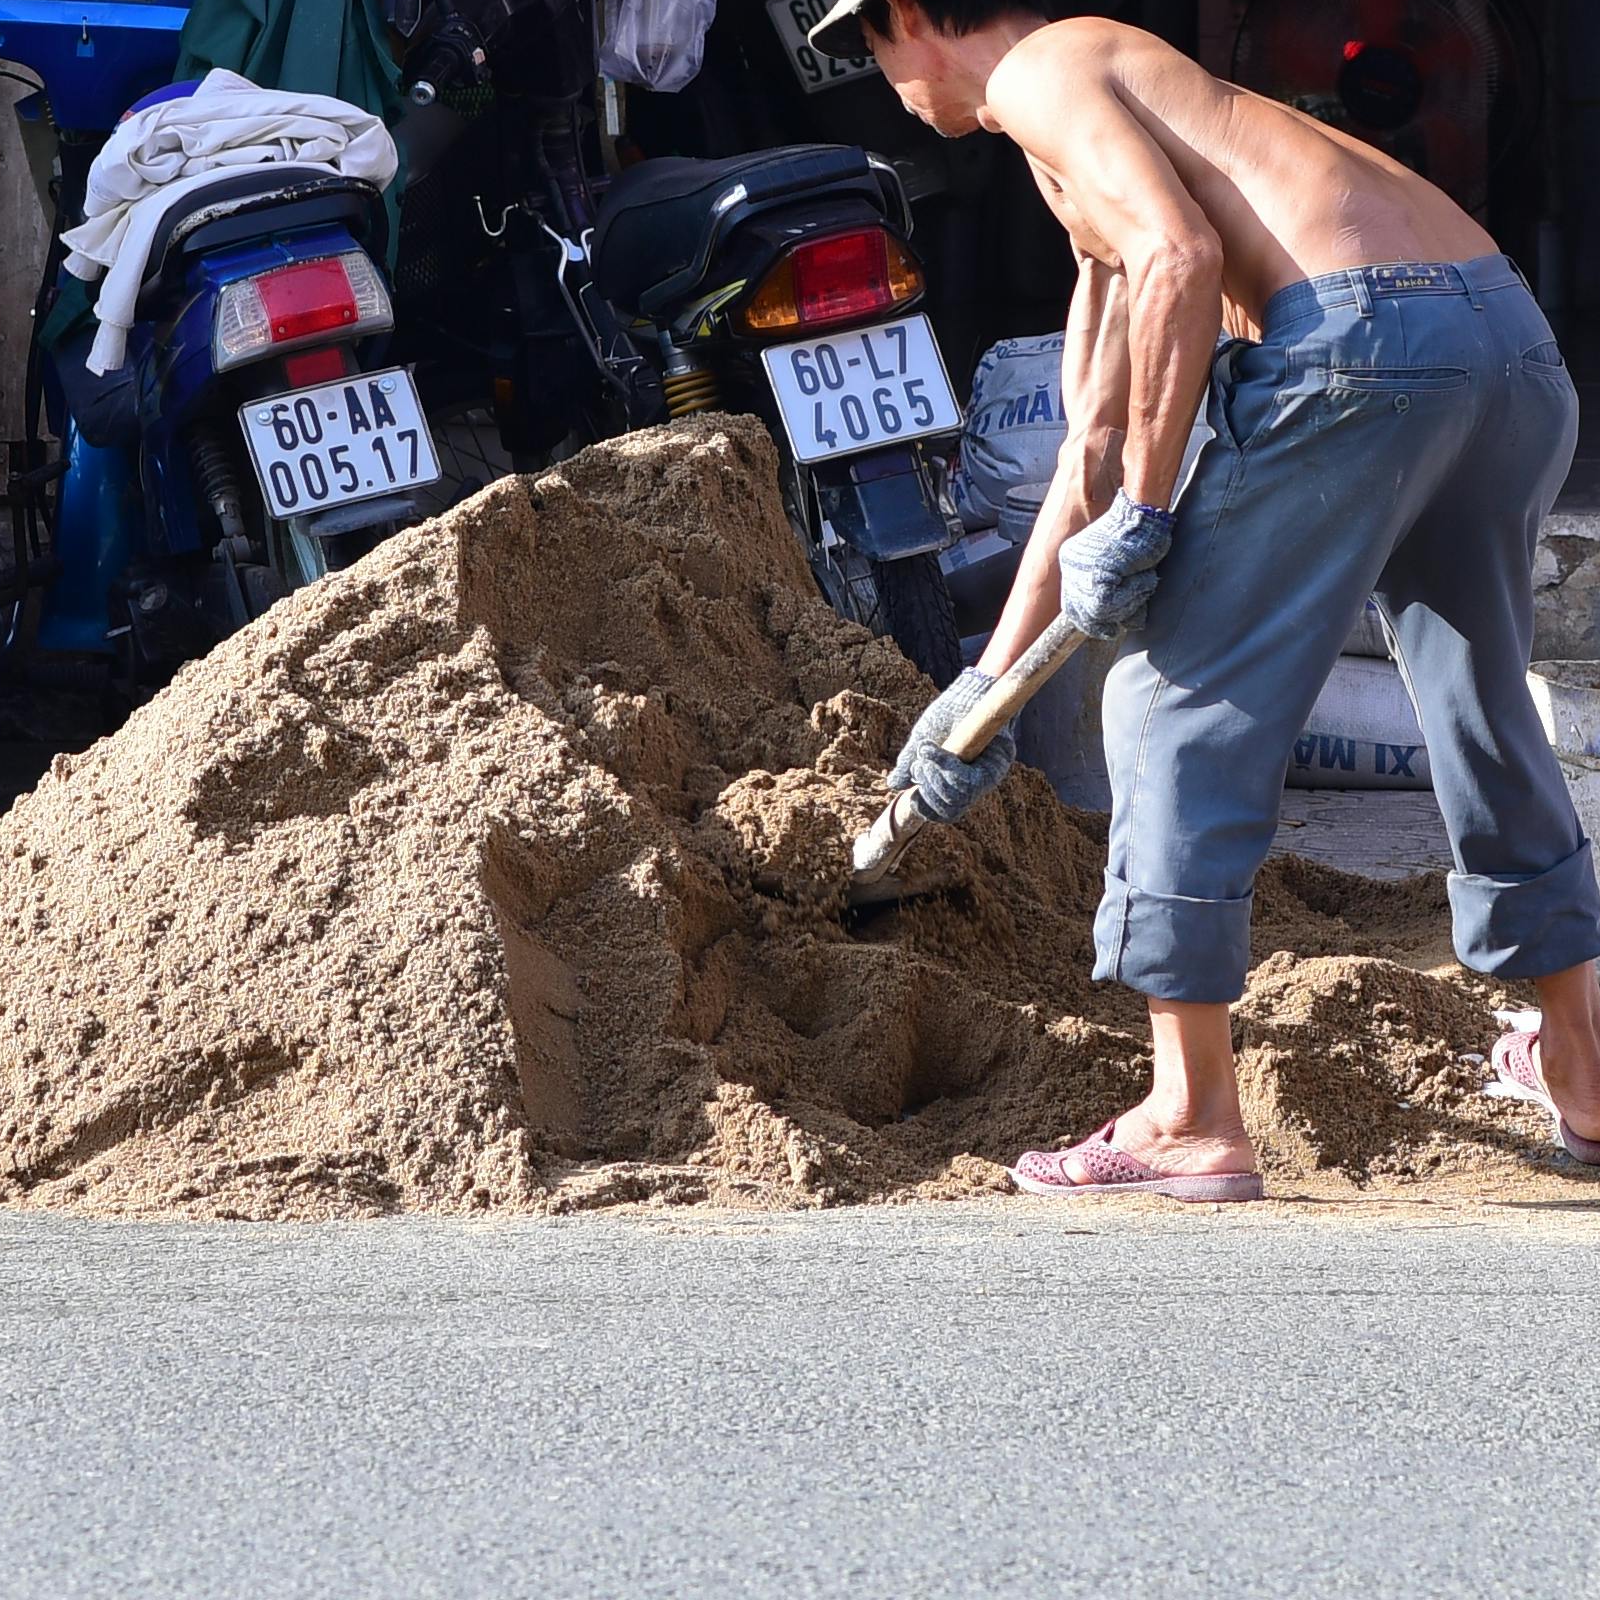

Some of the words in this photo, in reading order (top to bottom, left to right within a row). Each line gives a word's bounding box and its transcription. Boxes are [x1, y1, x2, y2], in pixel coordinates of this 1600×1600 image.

[790, 326, 909, 397] 60-L7
[271, 380, 397, 451] 60-AA
[813, 378, 936, 450] 4065
[269, 428, 420, 509] 005.17
[1375, 743, 1418, 778] XI
